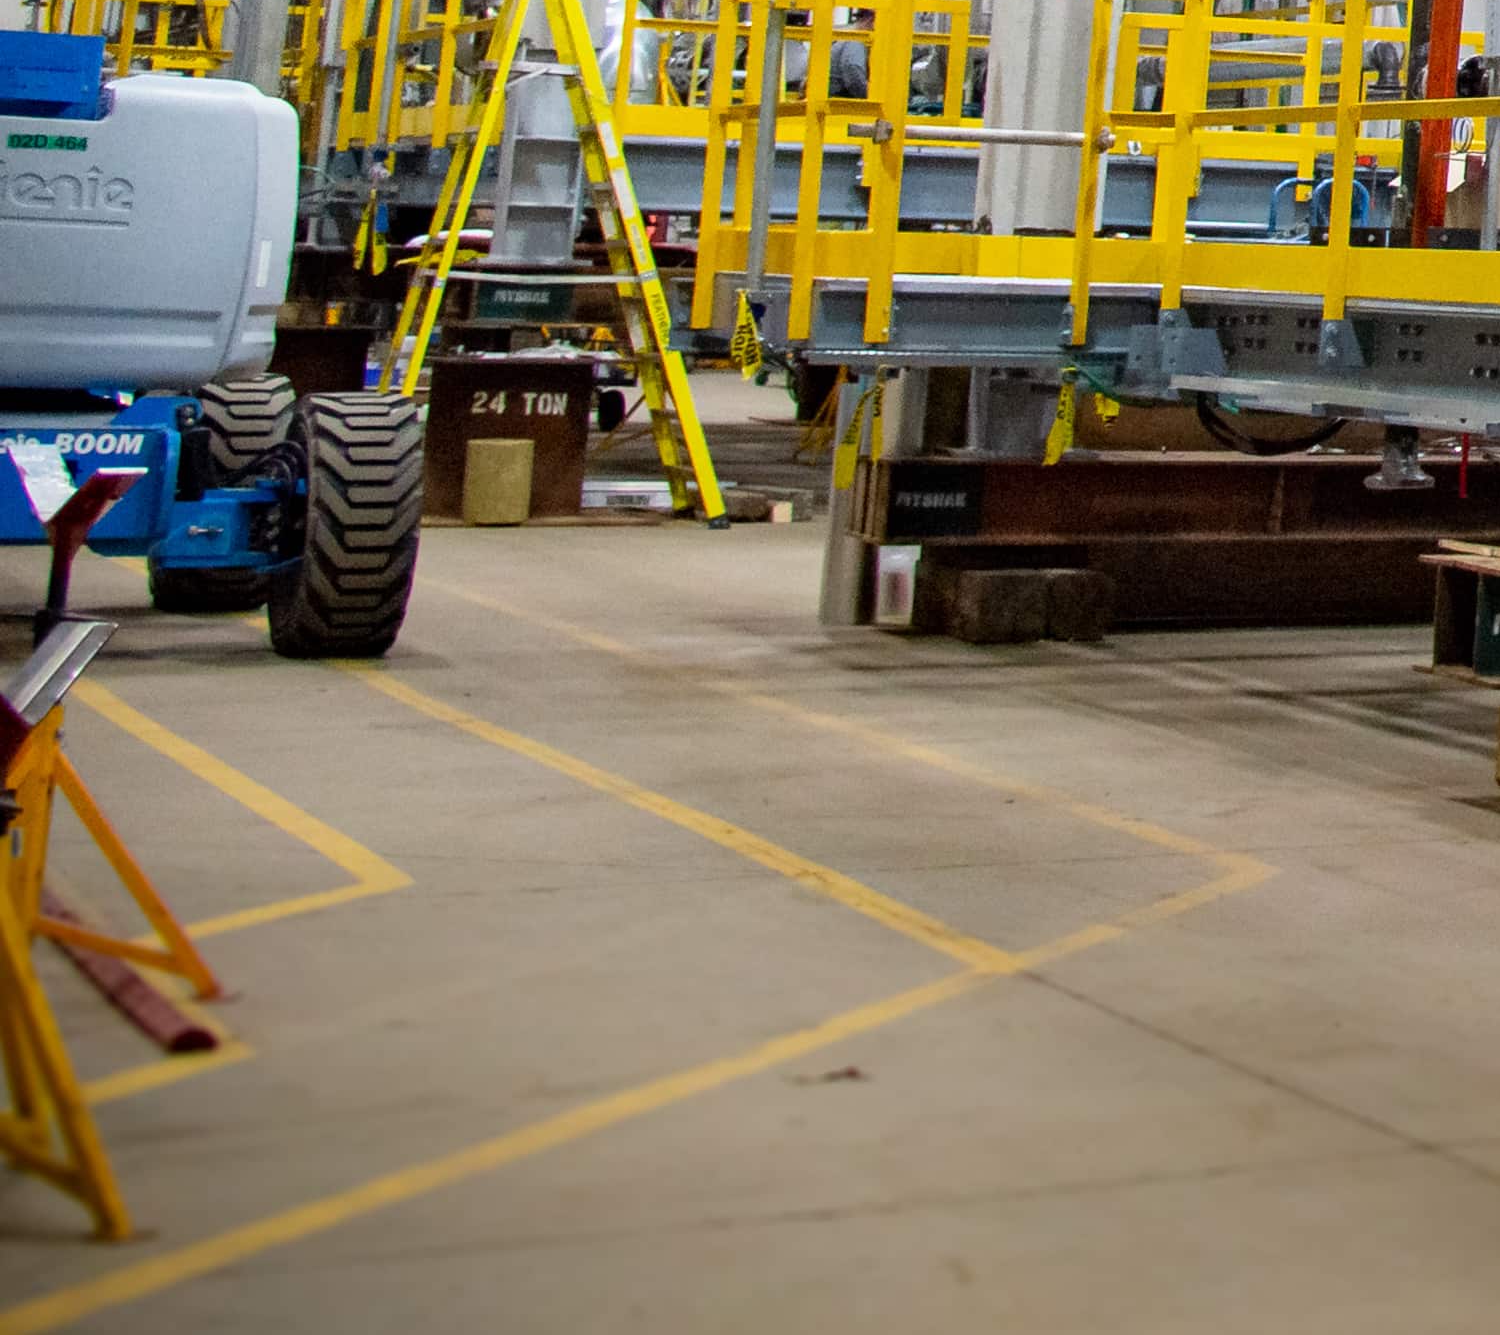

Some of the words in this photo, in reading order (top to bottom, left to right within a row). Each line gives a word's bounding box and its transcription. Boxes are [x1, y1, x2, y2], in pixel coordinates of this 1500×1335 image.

[0, 159, 134, 212] enie
[471, 391, 507, 415] 24
[522, 392, 569, 416] TON
[56, 432, 145, 455] BOOM
